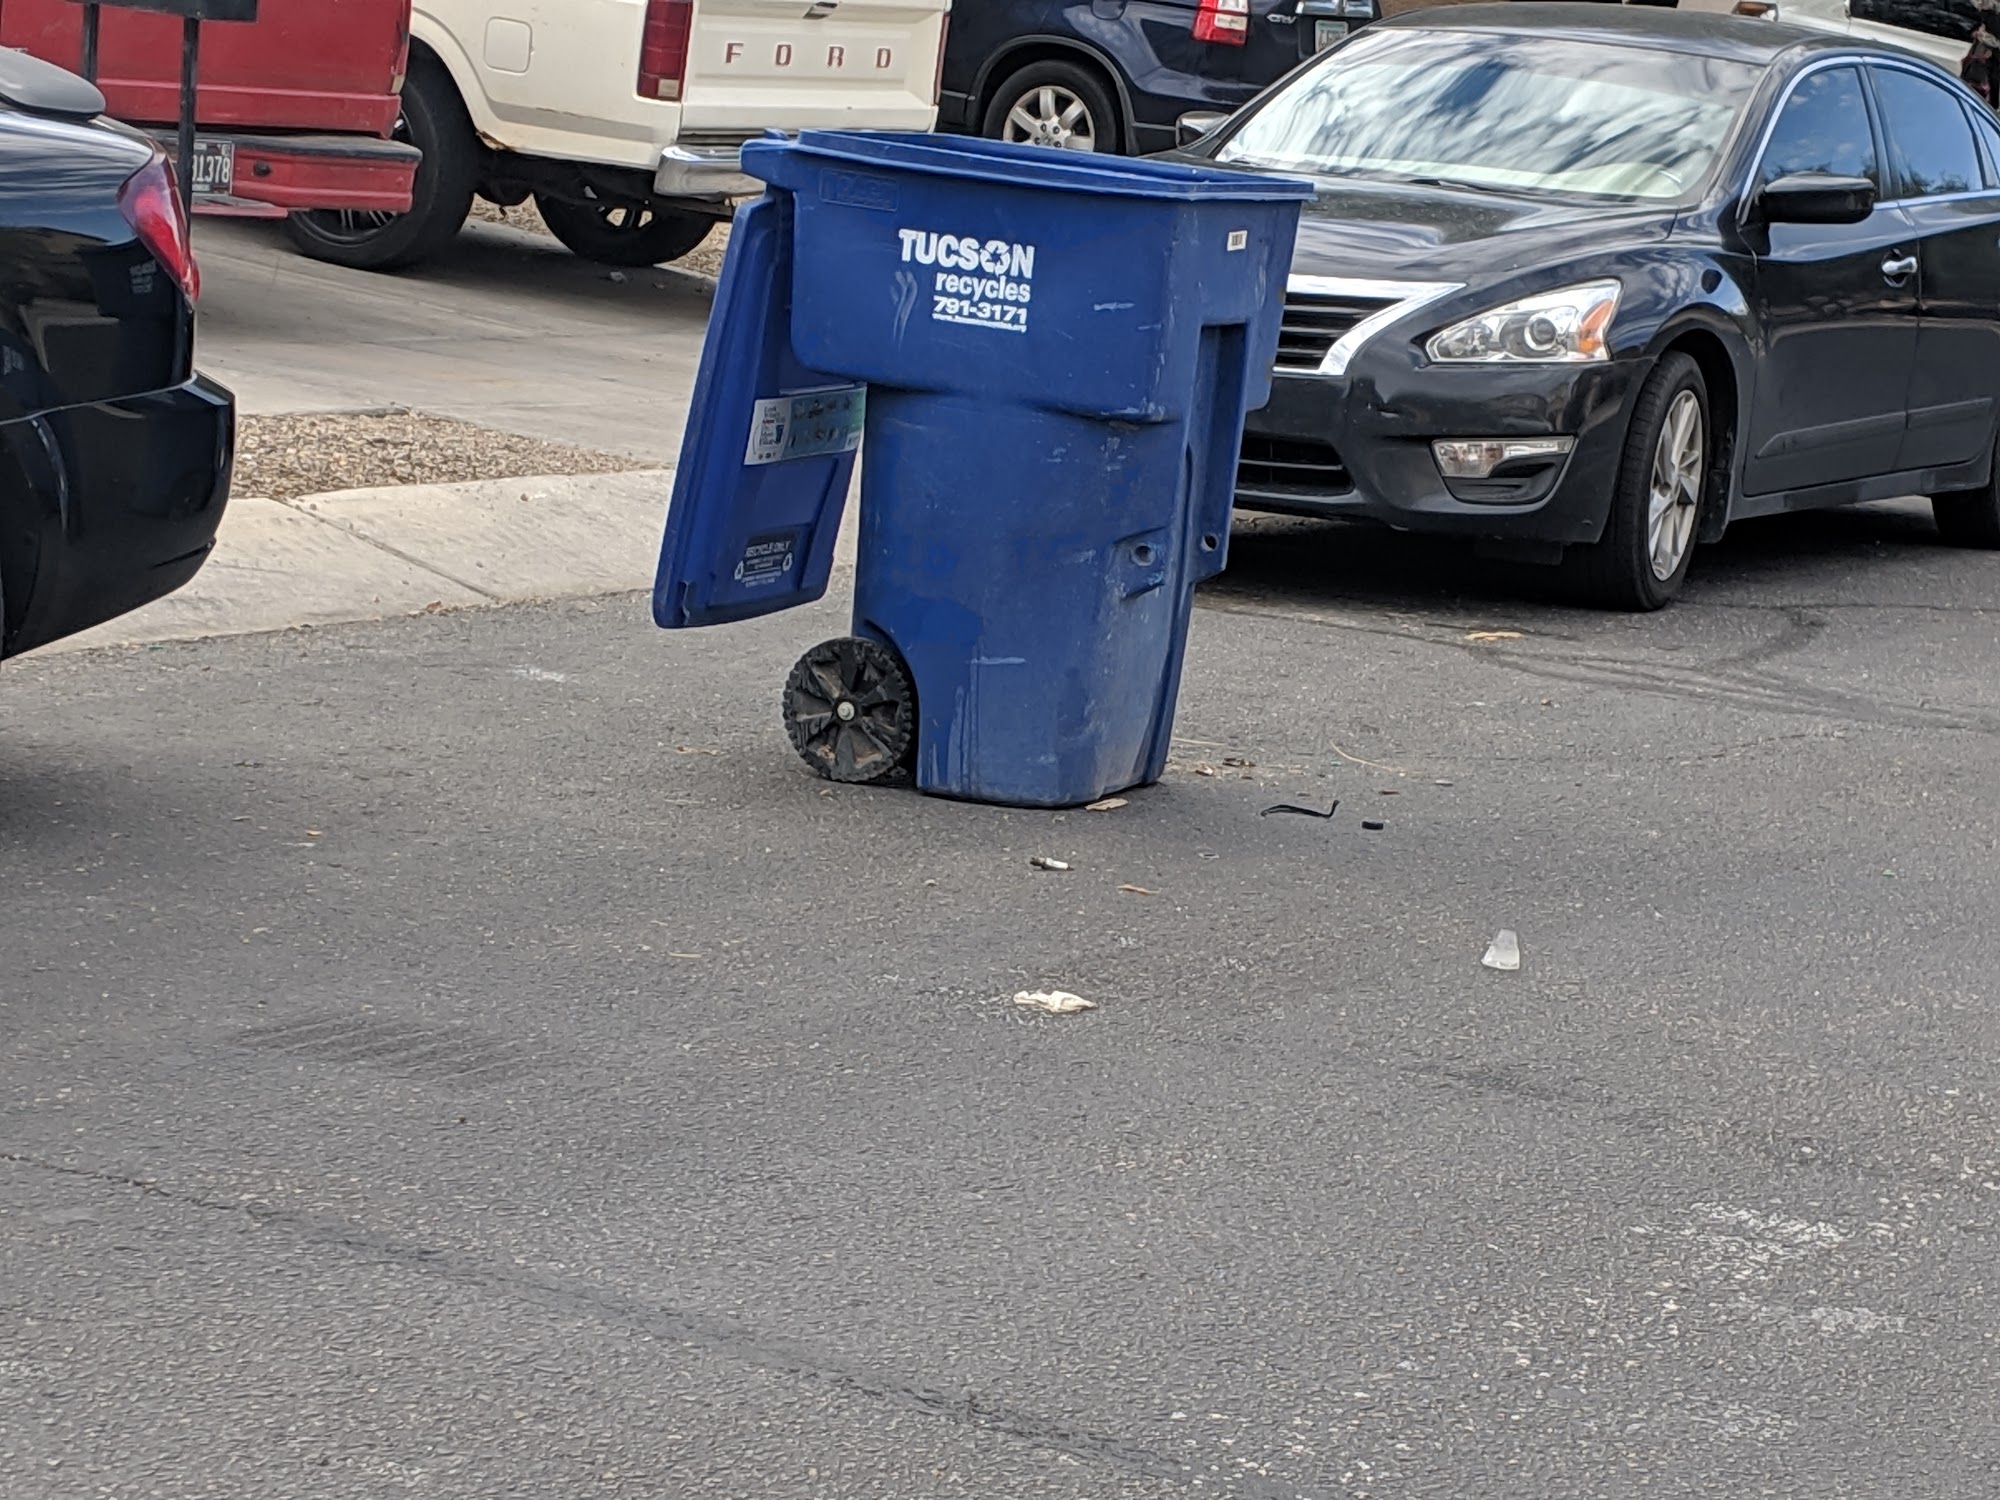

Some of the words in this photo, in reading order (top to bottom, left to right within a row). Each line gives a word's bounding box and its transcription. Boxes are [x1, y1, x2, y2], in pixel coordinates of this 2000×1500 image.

[725, 42, 892, 69] FORD
[898, 228, 1035, 279] TUCSON
[935, 272, 1031, 303] recycles
[933, 295, 1028, 325] 791-3171
